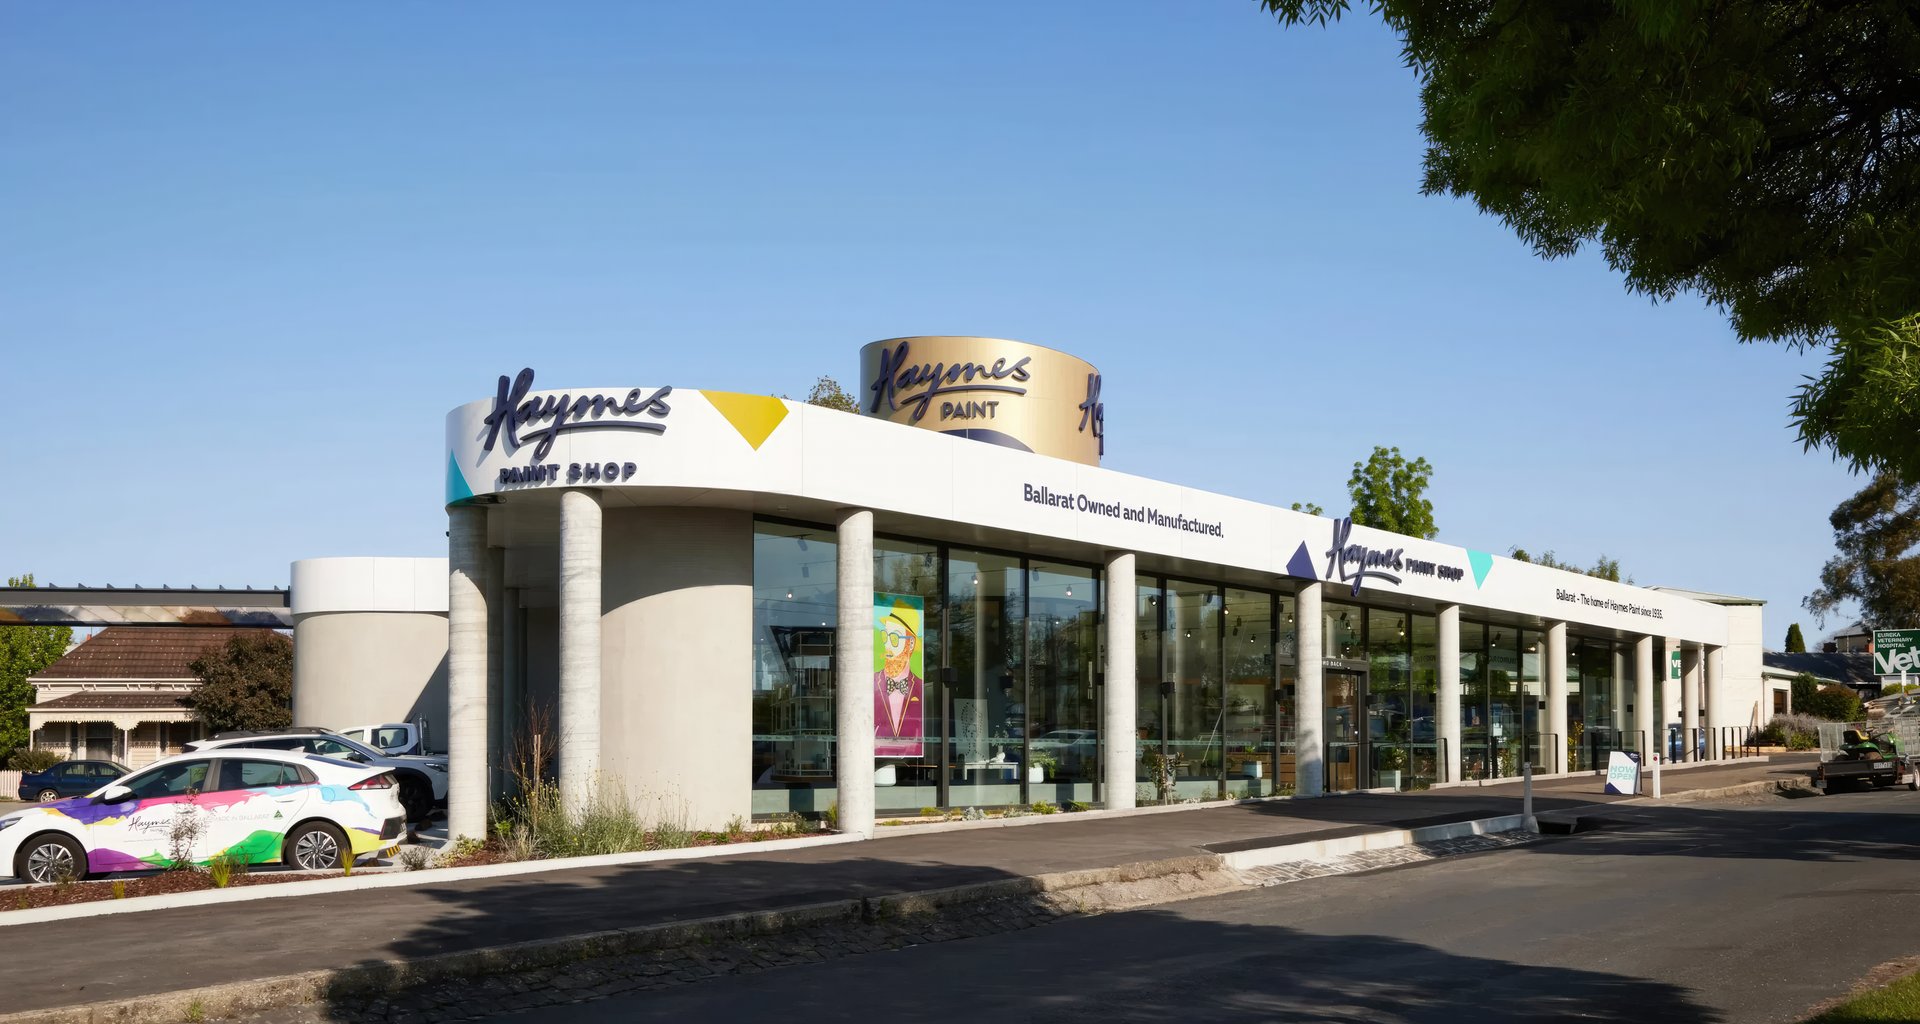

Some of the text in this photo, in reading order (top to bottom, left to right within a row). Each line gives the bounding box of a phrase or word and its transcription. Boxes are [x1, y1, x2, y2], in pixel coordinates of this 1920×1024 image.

[871, 341, 1031, 420] Haymes
[484, 367, 673, 461] Haymes
[942, 401, 1000, 421] PAINT
[500, 461, 638, 484] PAINT SHOP
[1024, 483, 1225, 538] Ballarat Owned and Manufactured.
[1325, 516, 1464, 597] Haymes PAINT SHOP
[1556, 589, 1576, 603] Ballarat
[1580, 593, 1590, 606] The
[1590, 595, 1604, 608] home
[1604, 599, 1610, 609] of
[1610, 600, 1629, 613] Haymes
[1629, 603, 1641, 615] Paint
[1641, 606, 1652, 617] since
[1874, 646, 1920, 674] Vet
[1610, 765, 1635, 773] NOW
[1610, 772, 1635, 780] OPEN
